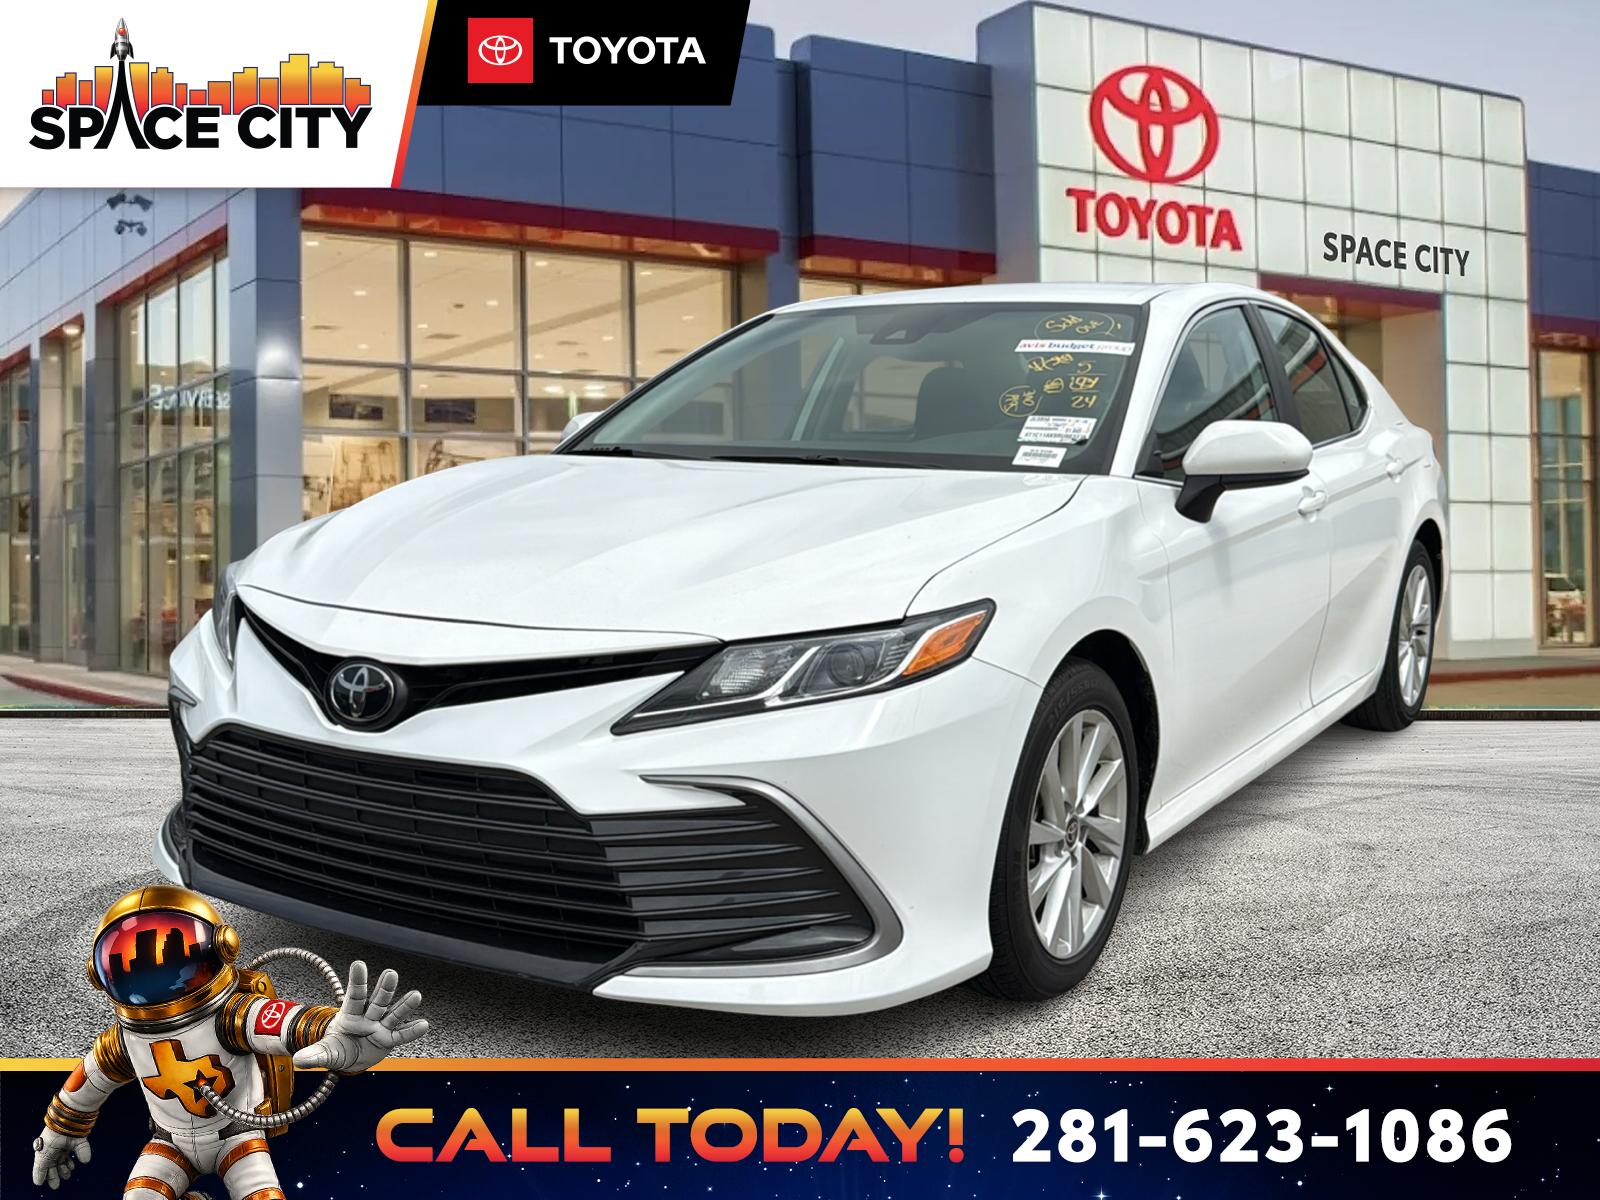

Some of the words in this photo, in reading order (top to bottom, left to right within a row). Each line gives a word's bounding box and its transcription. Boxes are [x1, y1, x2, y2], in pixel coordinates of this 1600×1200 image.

[1066, 187, 1242, 252] TOYOTA
[1322, 231, 1407, 270] SPACE
[1414, 244, 1470, 277] CITY
